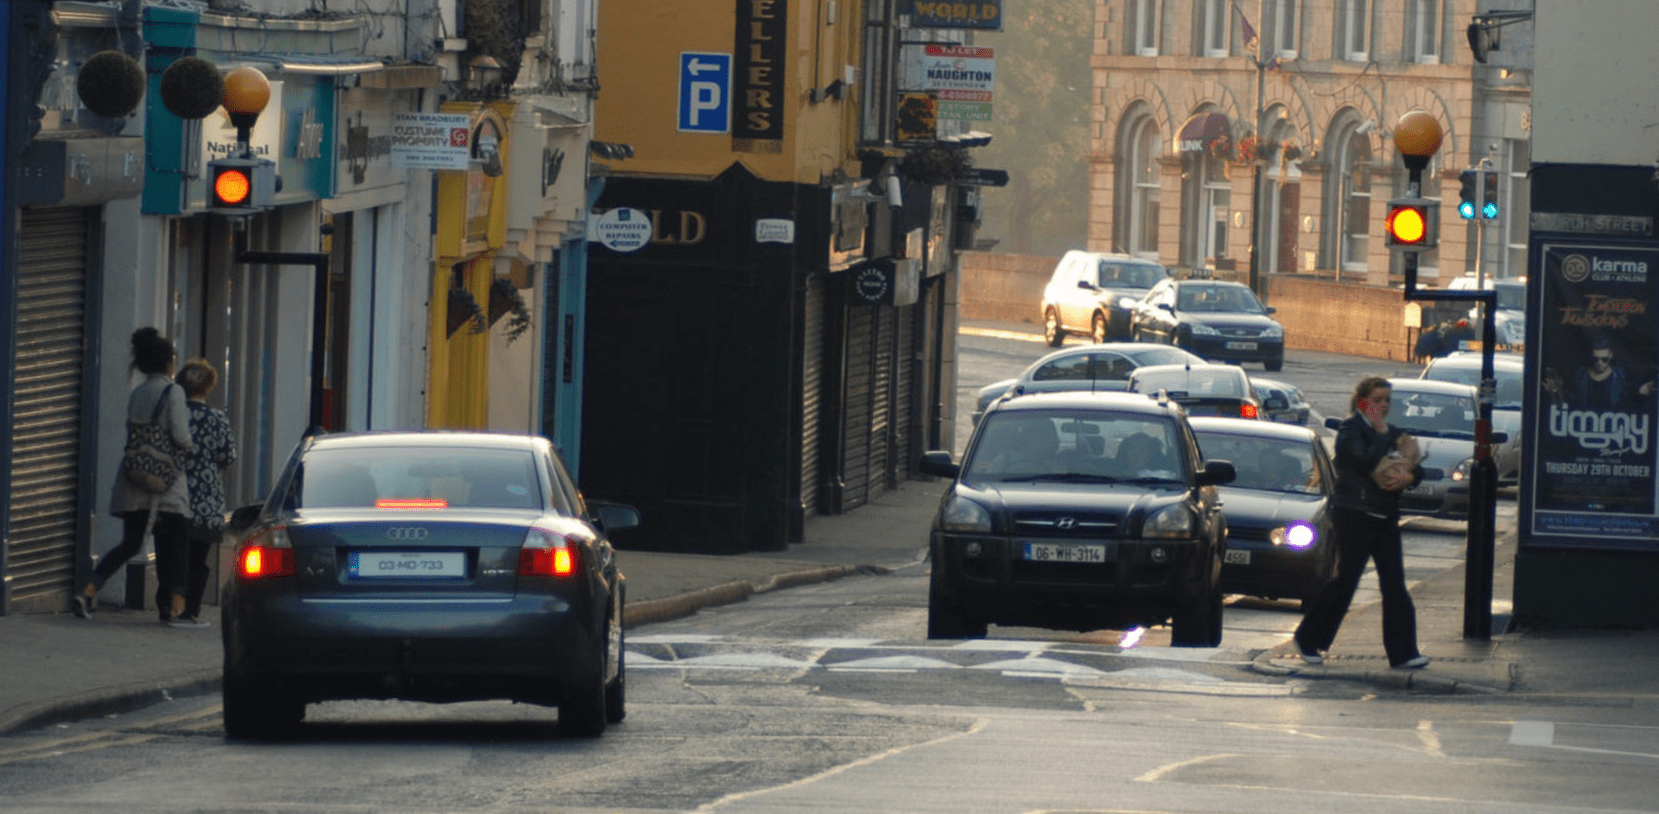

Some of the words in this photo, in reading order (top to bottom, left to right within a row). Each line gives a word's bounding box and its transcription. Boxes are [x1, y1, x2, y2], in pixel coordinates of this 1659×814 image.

[915, 2, 998, 21] WORLD
[927, 69, 992, 81] NAUGHTON
[689, 81, 721, 126] P
[207, 141, 270, 155] Natial
[391, 136, 448, 146] PROPERTY
[600, 223, 647, 231] COMPUTER
[1594, 217, 1648, 231] STREET
[1592, 256, 1648, 273] karma
[1546, 462, 1588, 475] THURSDAY
[1590, 464, 1611, 475] 29TH
[1613, 465, 1650, 477] OCTOBER
[1035, 547, 1100, 562] 06-WH-3114
